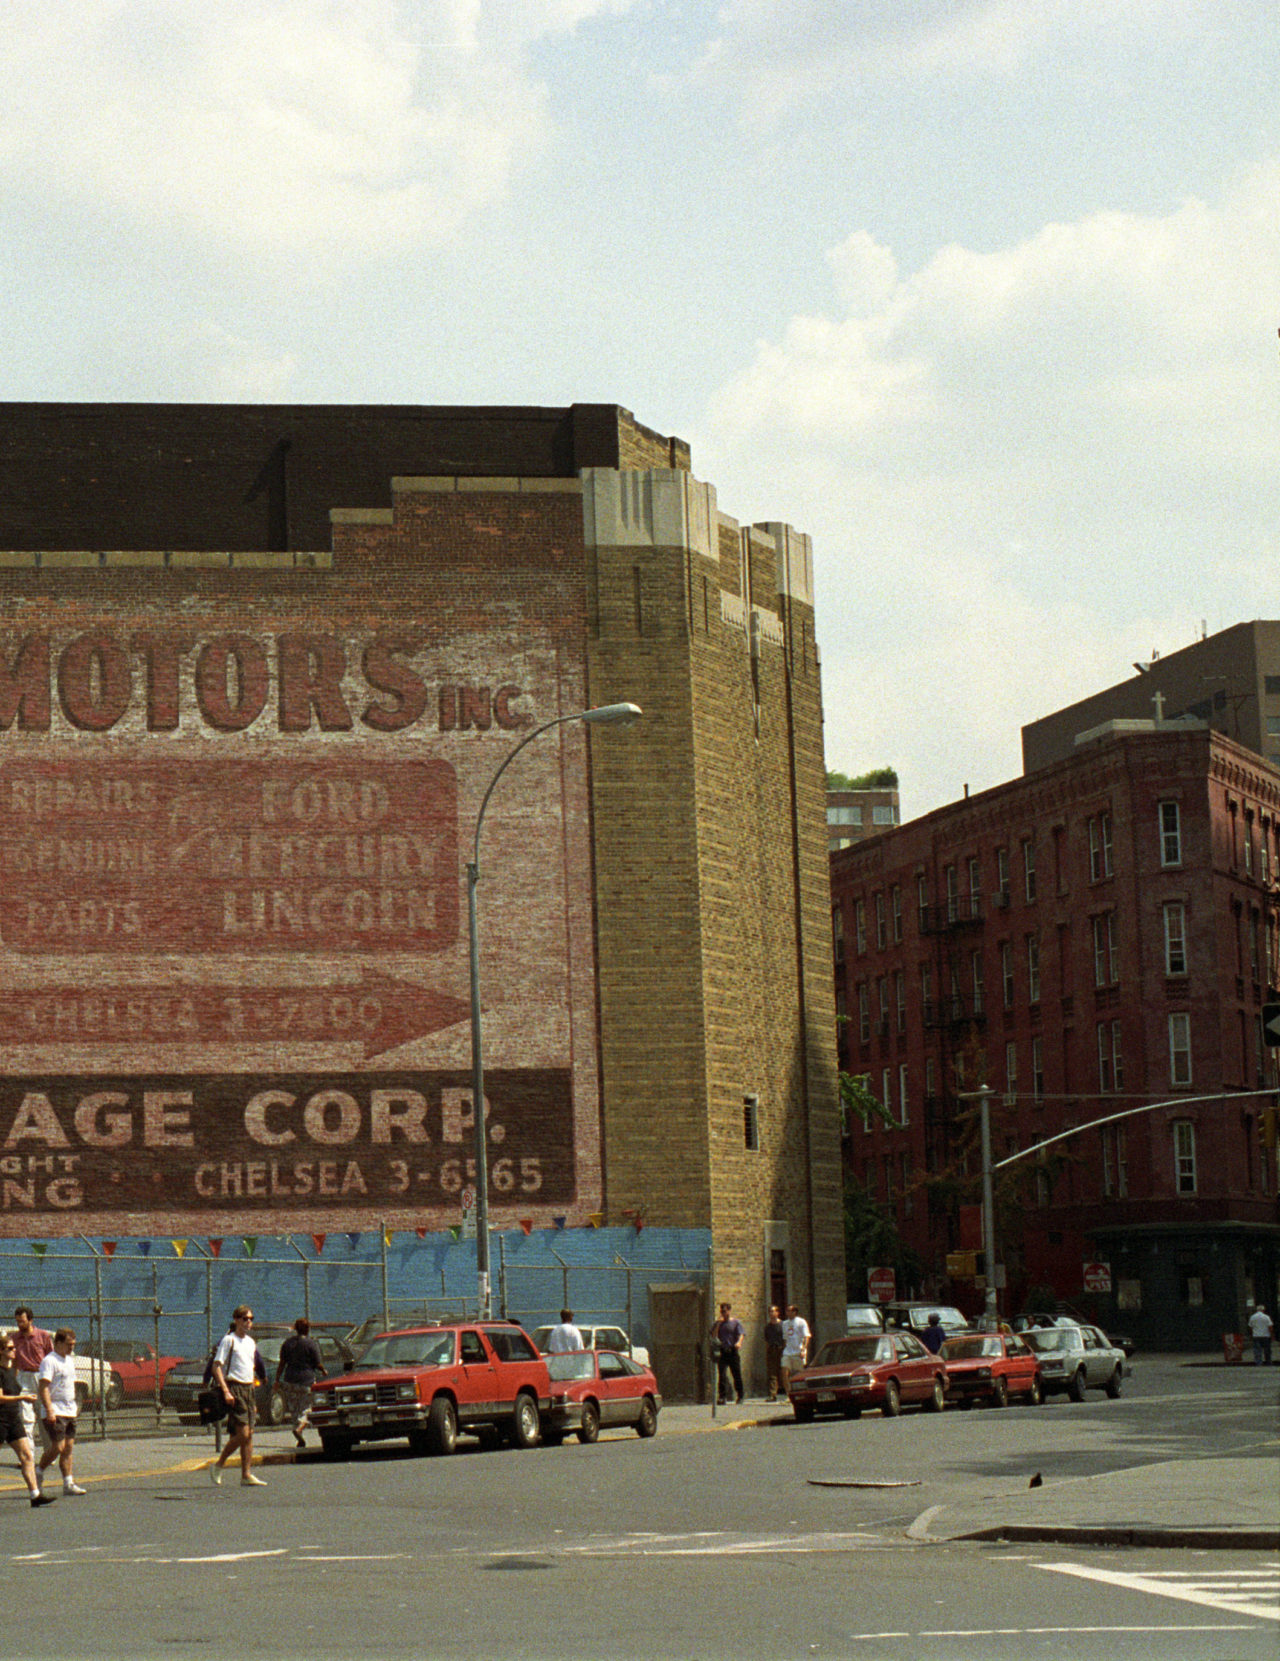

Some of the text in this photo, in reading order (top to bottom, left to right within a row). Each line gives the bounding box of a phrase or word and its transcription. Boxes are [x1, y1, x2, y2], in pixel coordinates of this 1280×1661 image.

[10, 779, 157, 814] REPAIRS
[262, 779, 391, 823] FORD
[209, 833, 446, 878] MERCURY
[26, 900, 143, 933] PARTS
[223, 889, 437, 932] LINCOLN
[243, 1086, 508, 1148] CORP.
[195, 1159, 369, 1197] CHELSEA
